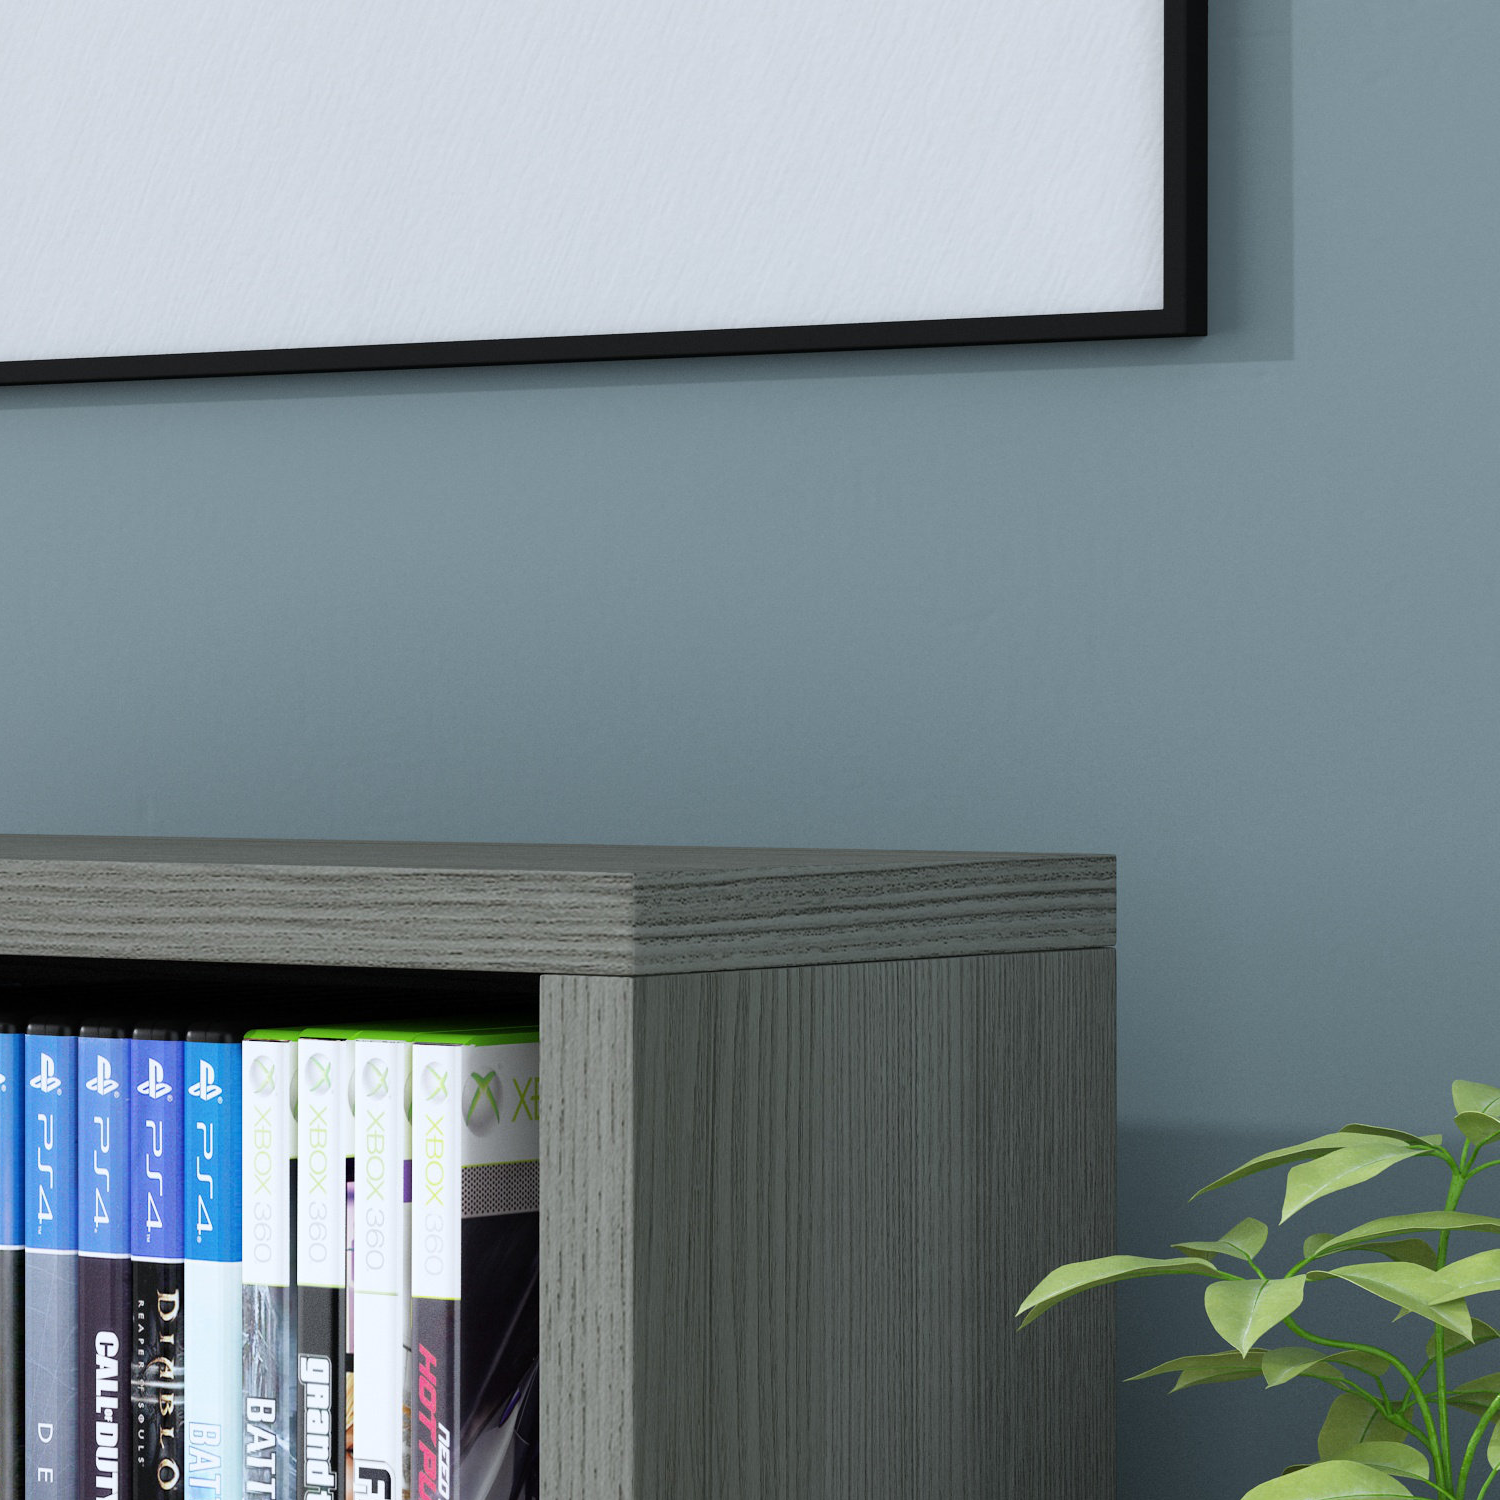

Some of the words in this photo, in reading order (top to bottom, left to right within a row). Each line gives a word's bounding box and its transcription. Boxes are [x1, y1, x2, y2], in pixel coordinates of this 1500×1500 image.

[253, 1105, 272, 1195] XBOX
[309, 1104, 328, 1195] XBOX
[366, 1110, 385, 1201] XBOX
[425, 1115, 444, 1206] XBOX
[253, 1201, 271, 1263] 360
[308, 1201, 328, 1263] 360
[365, 1207, 385, 1270] 360
[424, 1213, 444, 1276] 360
[95, 1331, 119, 1414] CALL
[137, 1299, 145, 1369] REAPER
[156, 1288, 180, 1491] DIABLO
[418, 1343, 437, 1448] HOT
[137, 1402, 145, 1464] SOULS
[437, 1422, 450, 1500] NEED
